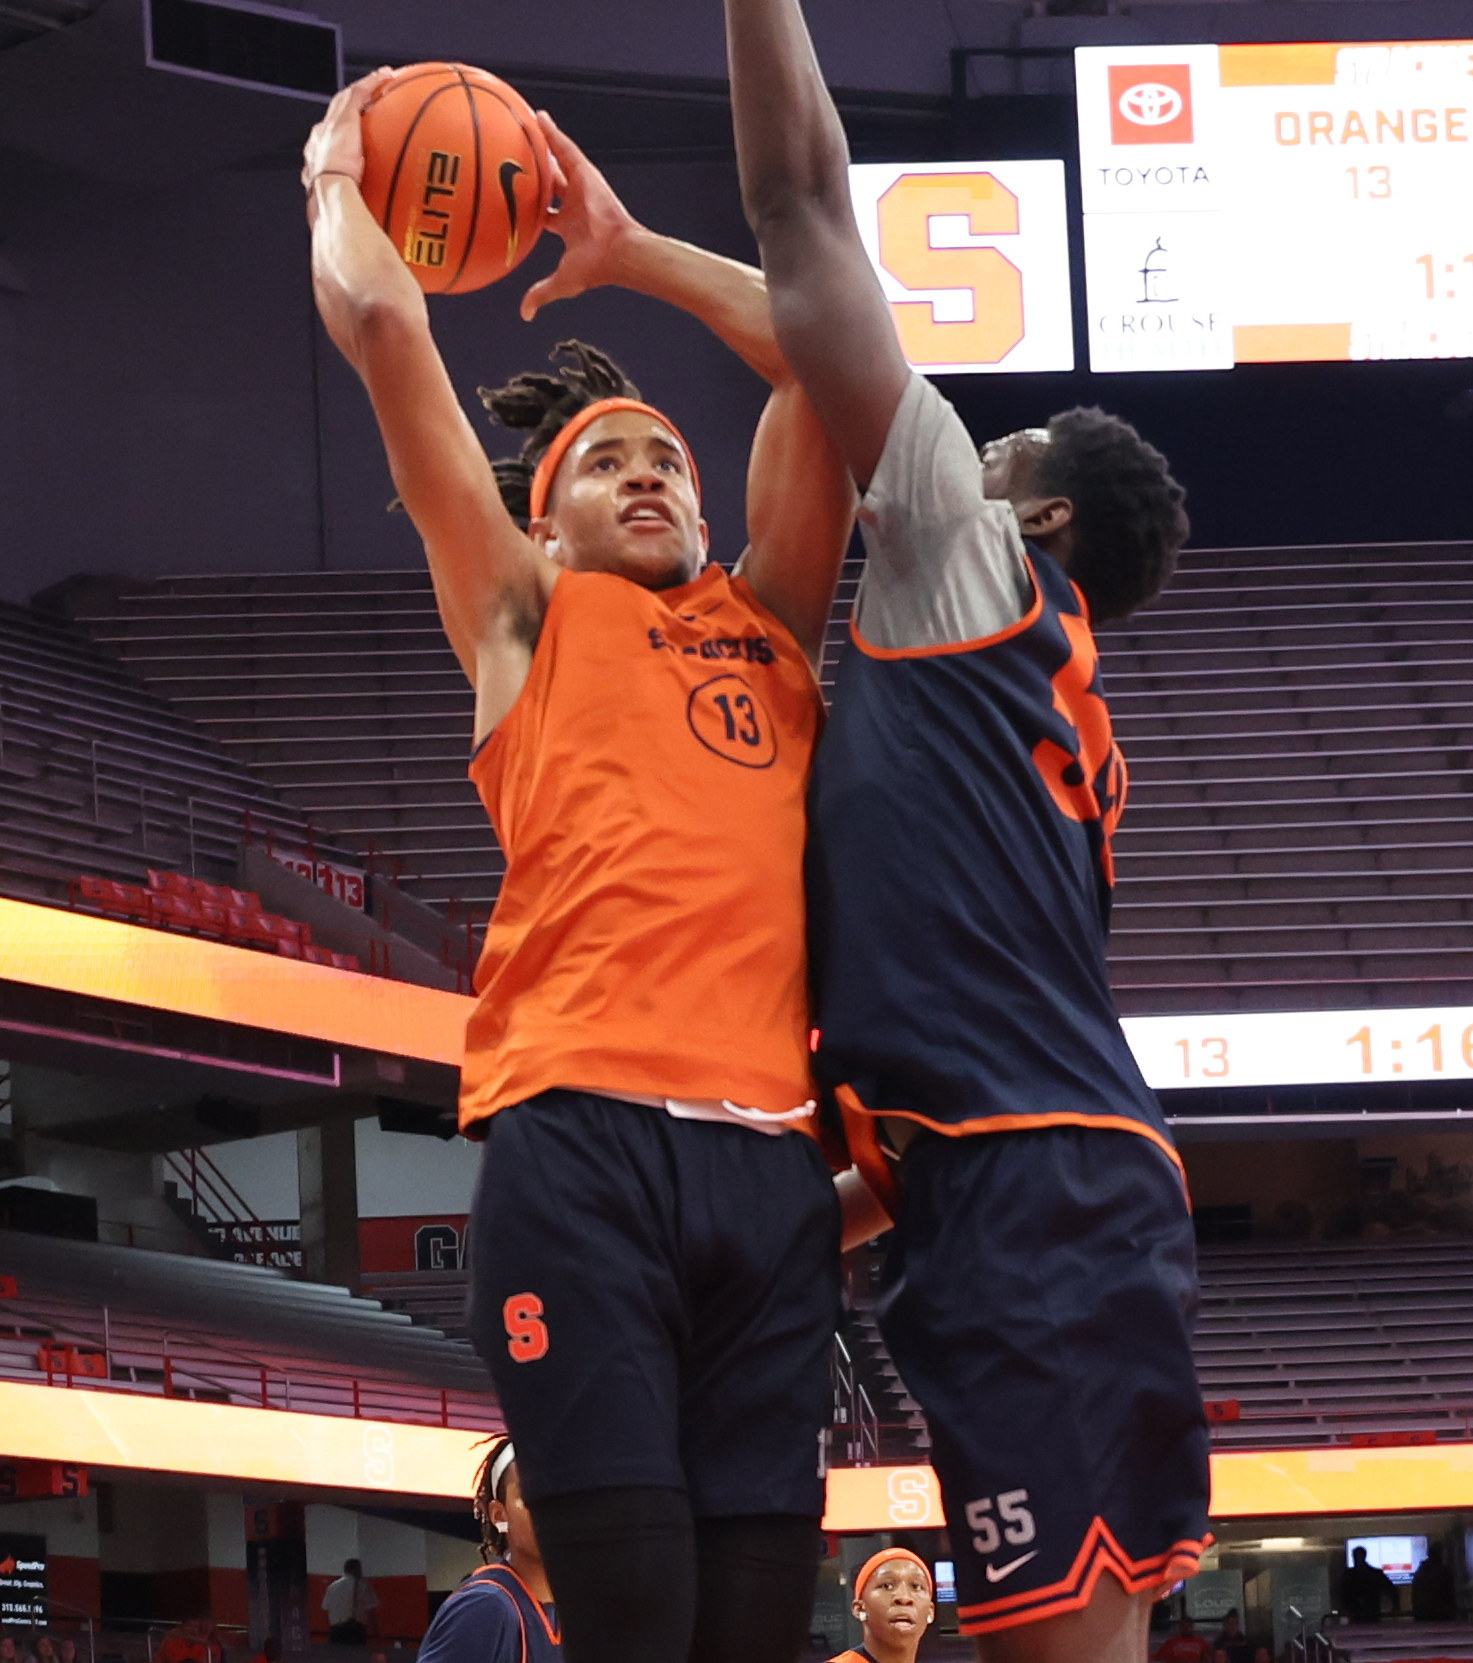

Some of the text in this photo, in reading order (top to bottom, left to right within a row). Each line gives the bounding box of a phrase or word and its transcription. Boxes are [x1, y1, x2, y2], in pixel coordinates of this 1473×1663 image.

[1274, 108, 1469, 146] ORANGE
[1098, 166, 1210, 186] TOYOTA
[1345, 165, 1393, 200] 13
[415, 151, 461, 267] ELITE
[876, 171, 1026, 366] S
[1099, 312, 1222, 334] CROUSE
[713, 693, 761, 747] 13
[1174, 1036, 1230, 1079] 13
[503, 1292, 550, 1364] S
[362, 1424, 394, 1487] S
[888, 1468, 931, 1525] S
[964, 1488, 1037, 1555] 55
